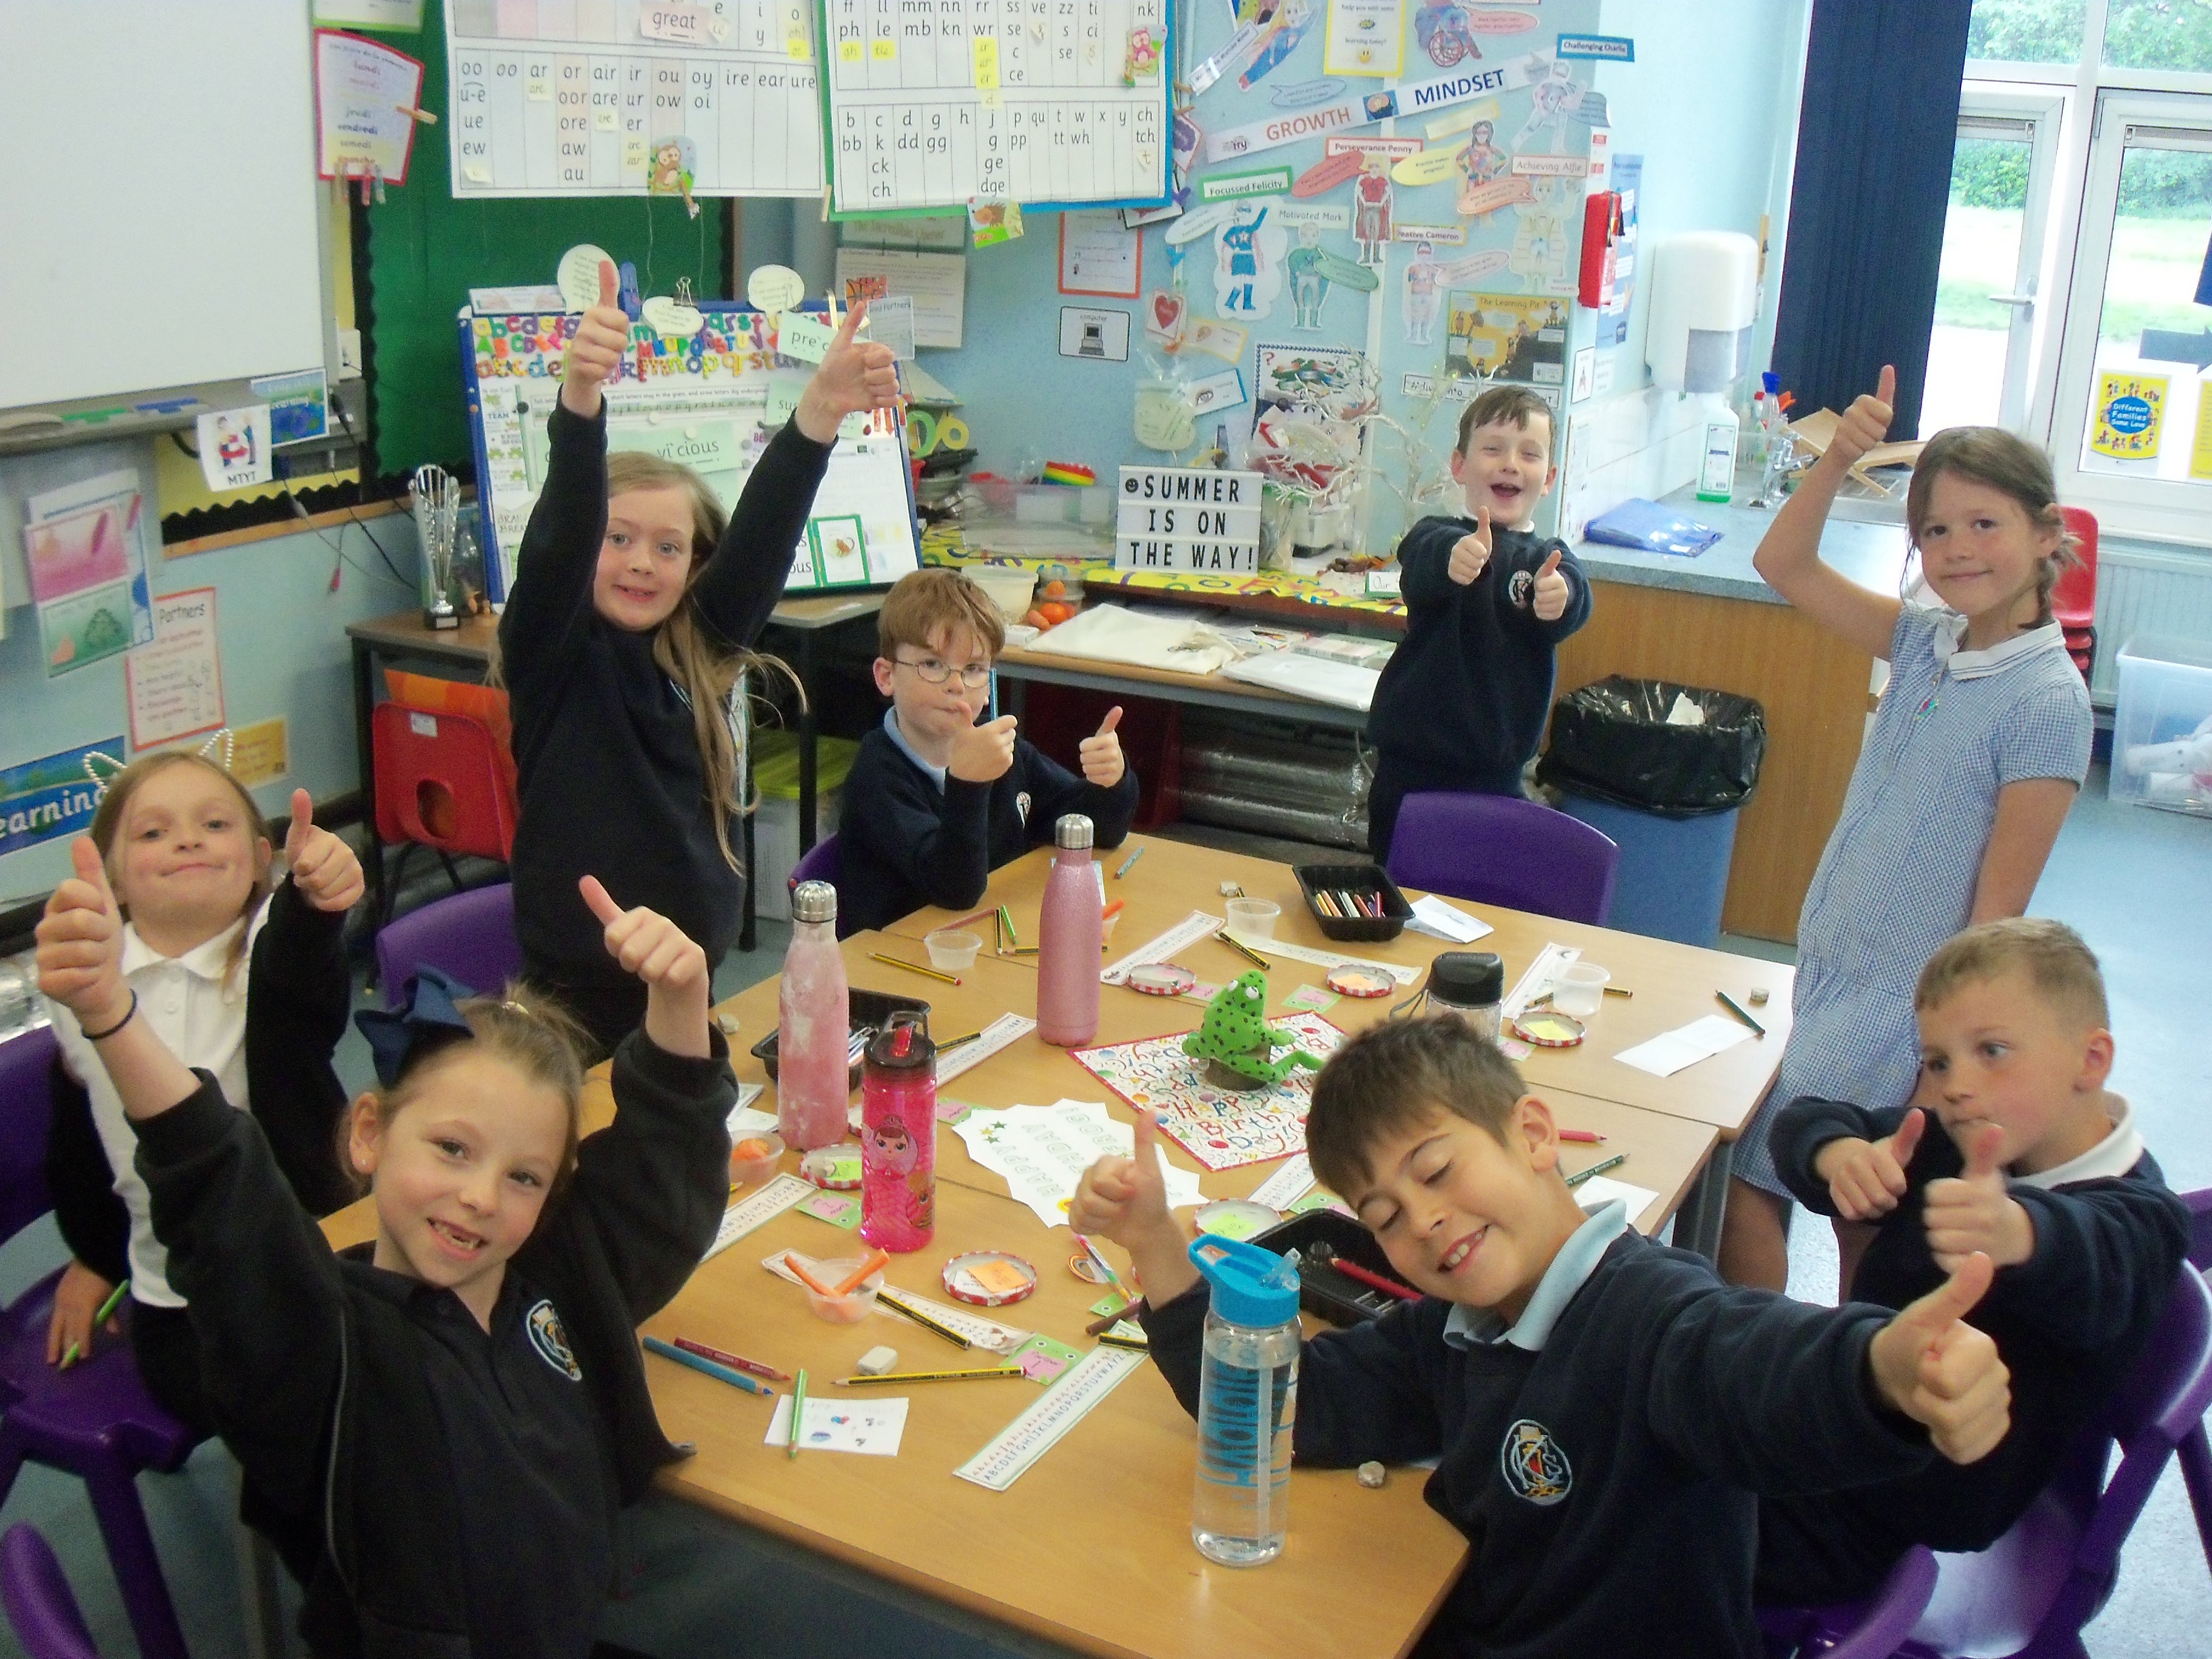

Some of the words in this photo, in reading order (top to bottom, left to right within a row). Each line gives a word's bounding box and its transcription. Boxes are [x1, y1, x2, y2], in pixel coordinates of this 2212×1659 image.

[715, 3, 723, 13] e
[759, 2, 762, 17] i
[792, 9, 799, 20] o
[903, 1, 931, 12] mm
[941, 2, 960, 12] nn
[976, 2, 988, 12] rr
[1007, 2, 1019, 12] ss
[1032, 3, 1045, 13] ve
[1059, 4, 1073, 14] zz
[1138, 2, 1153, 16] nk
[653, 12, 695, 29] great
[757, 30, 764, 46] y
[840, 21, 859, 41] ph
[877, 20, 890, 36] le
[906, 20, 930, 35] mb
[943, 20, 960, 35] kn
[974, 25, 993, 35] wr
[1008, 25, 1021, 35] se
[1064, 26, 1068, 36] s
[1087, 24, 1097, 37] ci
[1013, 47, 1018, 58] c
[1059, 49, 1071, 59] se
[1564, 41, 1603, 52] Challenging
[462, 62, 481, 75] oo
[497, 64, 517, 76] oo
[531, 65, 546, 77] ar
[564, 67, 580, 78] or
[594, 68, 616, 79] air
[630, 66, 641, 81] ir
[659, 71, 679, 82] ou
[692, 72, 712, 89] oy
[727, 70, 749, 85] ire
[759, 75, 782, 86] ear
[792, 75, 816, 89] ure
[1010, 70, 1023, 81] ce
[1415, 69, 1504, 105] MINDSET
[559, 92, 587, 104] oor
[593, 93, 617, 105] are
[628, 95, 643, 106] ur
[657, 96, 680, 107] ow
[695, 93, 709, 108] oi
[465, 116, 483, 128] ue
[561, 118, 586, 130] ore
[628, 119, 642, 130] er
[847, 112, 854, 127] b
[876, 116, 882, 127] c
[903, 110, 911, 126] d
[932, 115, 940, 130] g
[960, 109, 968, 124] h
[990, 110, 993, 129] j
[1014, 113, 1021, 127] p
[1031, 113, 1044, 127] qu
[1057, 110, 1061, 122] t
[1075, 112, 1084, 122] w
[1100, 112, 1105, 121] x
[1120, 112, 1126, 126] y
[1138, 107, 1152, 121] ch
[1266, 107, 1351, 141] GROWTH
[338, 124, 378, 135] vendredi
[843, 135, 861, 150] bb
[877, 135, 883, 150] k
[898, 133, 918, 149] dd
[927, 137, 946, 153] gg
[989, 136, 997, 151] g
[1011, 135, 1026, 150] pp
[1054, 132, 1064, 144] tt
[1071, 130, 1089, 144] wh
[1136, 128, 1155, 142] tch
[463, 142, 485, 155] ew
[562, 144, 585, 155] aw
[1335, 143, 1386, 152] Perseverance
[1388, 145, 1412, 154] Penny
[873, 158, 888, 173] ck
[985, 158, 1003, 173] ge
[1517, 161, 1559, 172] Achieving
[1563, 162, 1582, 172] Alfie
[565, 169, 583, 180] au
[873, 181, 891, 197] ch
[981, 177, 1004, 194] dge
[1210, 183, 1250, 196] Focussed
[1252, 179, 1282, 193] Felicity
[1279, 210, 1319, 220] Motivated
[1322, 212, 1342, 221] Mark
[1397, 231, 1424, 240] reative
[1426, 230, 1459, 240] Cameron
[1480, 297, 1493, 306] The
[1495, 298, 1527, 309] Learning
[1080, 313, 1107, 323] computer
[2113, 402, 2148, 413] Different
[2112, 411, 2147, 421] Families
[227, 471, 257, 486] MTYT
[1144, 474, 1239, 502] SUMMER
[1149, 509, 1175, 533] IS
[1198, 511, 1226, 535] ON
[1130, 542, 1173, 566] THE
[1192, 544, 1253, 571] WAY!
[159, 603, 205, 623] Partners
[1171, 1093, 1270, 1119] Happy
[991, 1145, 1065, 1197] HAPPY
